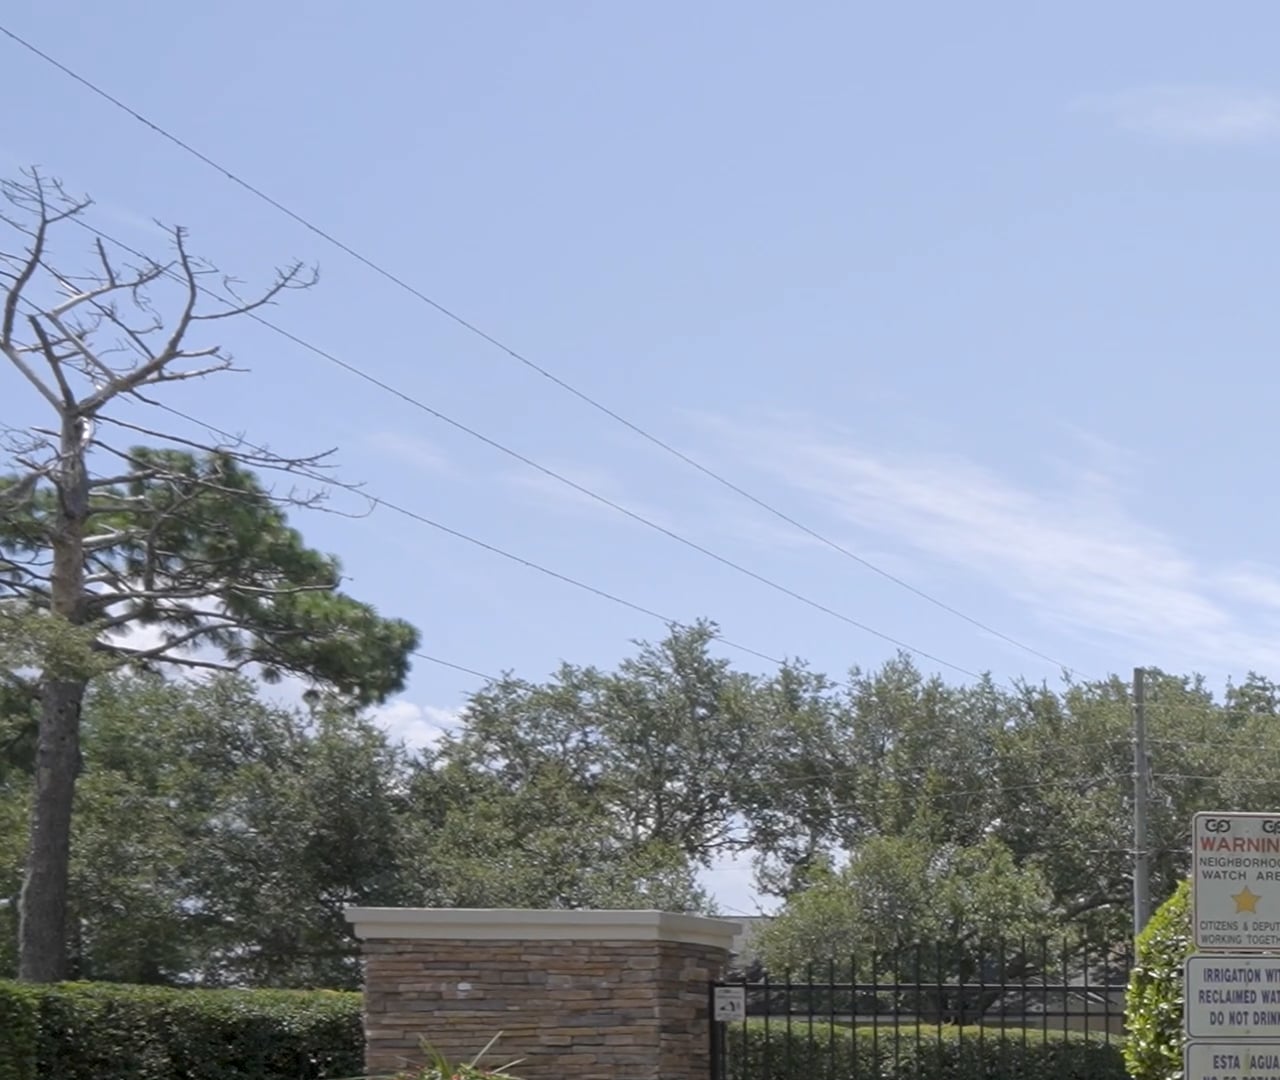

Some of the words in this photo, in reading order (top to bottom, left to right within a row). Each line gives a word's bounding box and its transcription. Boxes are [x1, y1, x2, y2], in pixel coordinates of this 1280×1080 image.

[1202, 871, 1247, 880] WATCH
[1200, 921, 1238, 931] CITIZENS
[1201, 935, 1242, 944] WORKING
[1203, 968, 1261, 983] IRRIGATION
[1199, 990, 1257, 1004] RECLAIMED
[1210, 1011, 1224, 1025] DO
[1229, 1011, 1249, 1025] NOT
[1213, 1055, 1240, 1069] ESTA
[1250, 1055, 1280, 1069] AGUA
